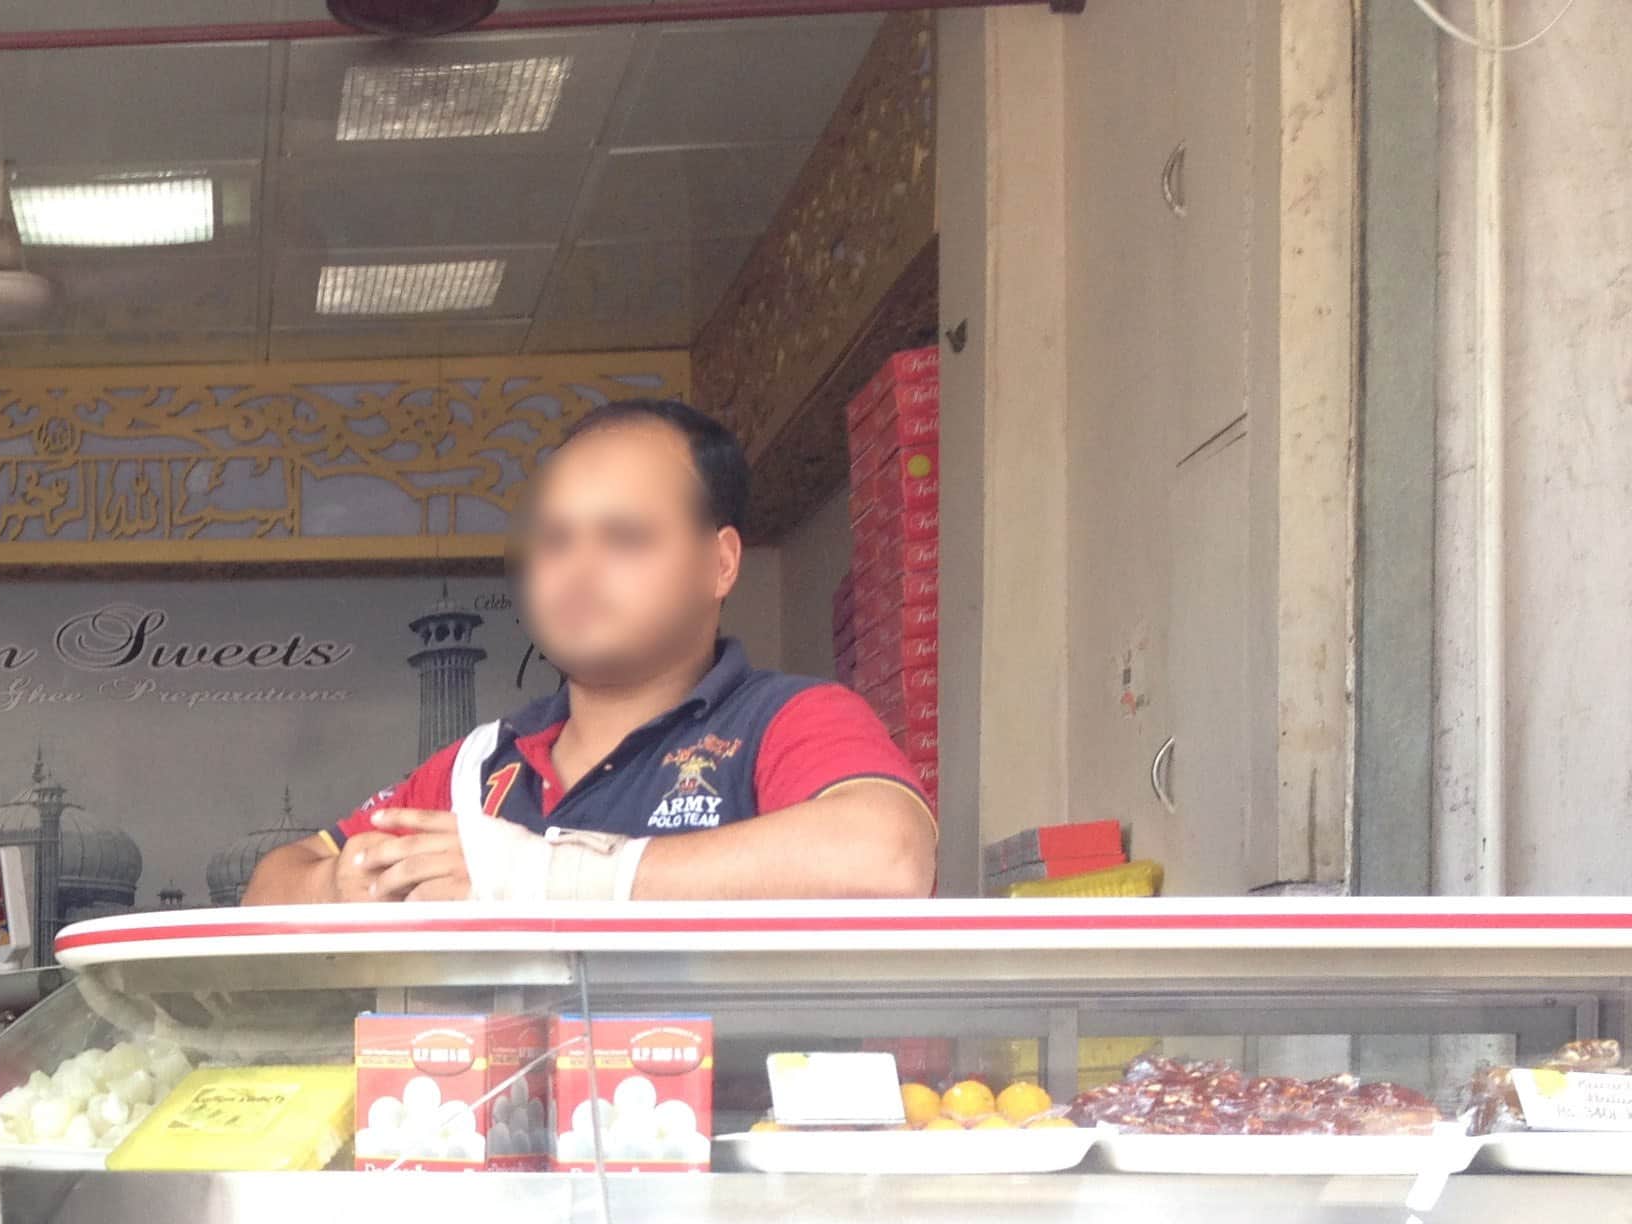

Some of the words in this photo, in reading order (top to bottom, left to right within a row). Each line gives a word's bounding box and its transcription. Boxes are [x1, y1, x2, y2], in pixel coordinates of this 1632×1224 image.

[55, 603, 353, 670] Sweets
[653, 795, 723, 816] ARMY
[648, 814, 682, 828] POLO
[683, 812, 720, 828] TEAM
